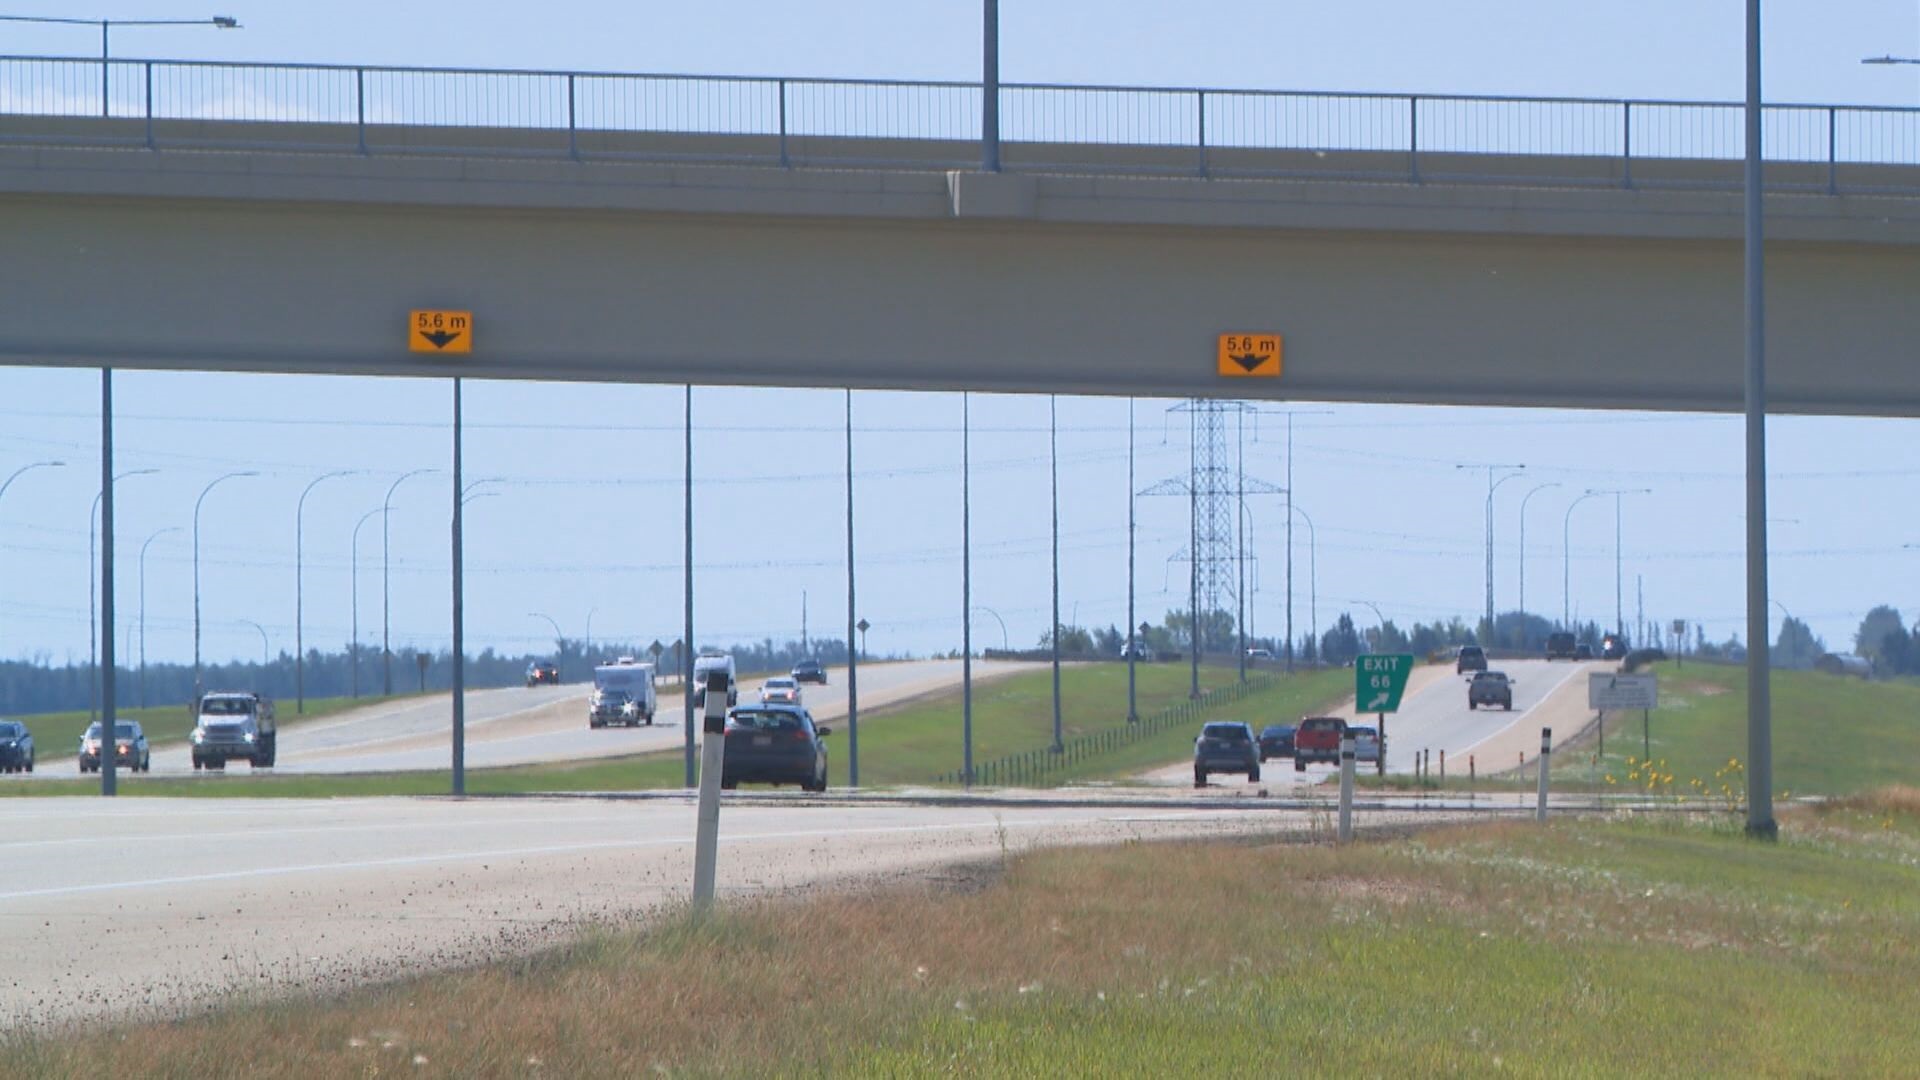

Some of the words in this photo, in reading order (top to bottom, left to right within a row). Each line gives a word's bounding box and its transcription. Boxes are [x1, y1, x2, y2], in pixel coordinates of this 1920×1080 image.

[418, 313, 443, 328] 5.6
[450, 317, 466, 328] m
[1227, 336, 1252, 351] 5.6
[1260, 340, 1275, 352] m
[1364, 657, 1399, 672] EXIT
[1370, 674, 1391, 688] 66
